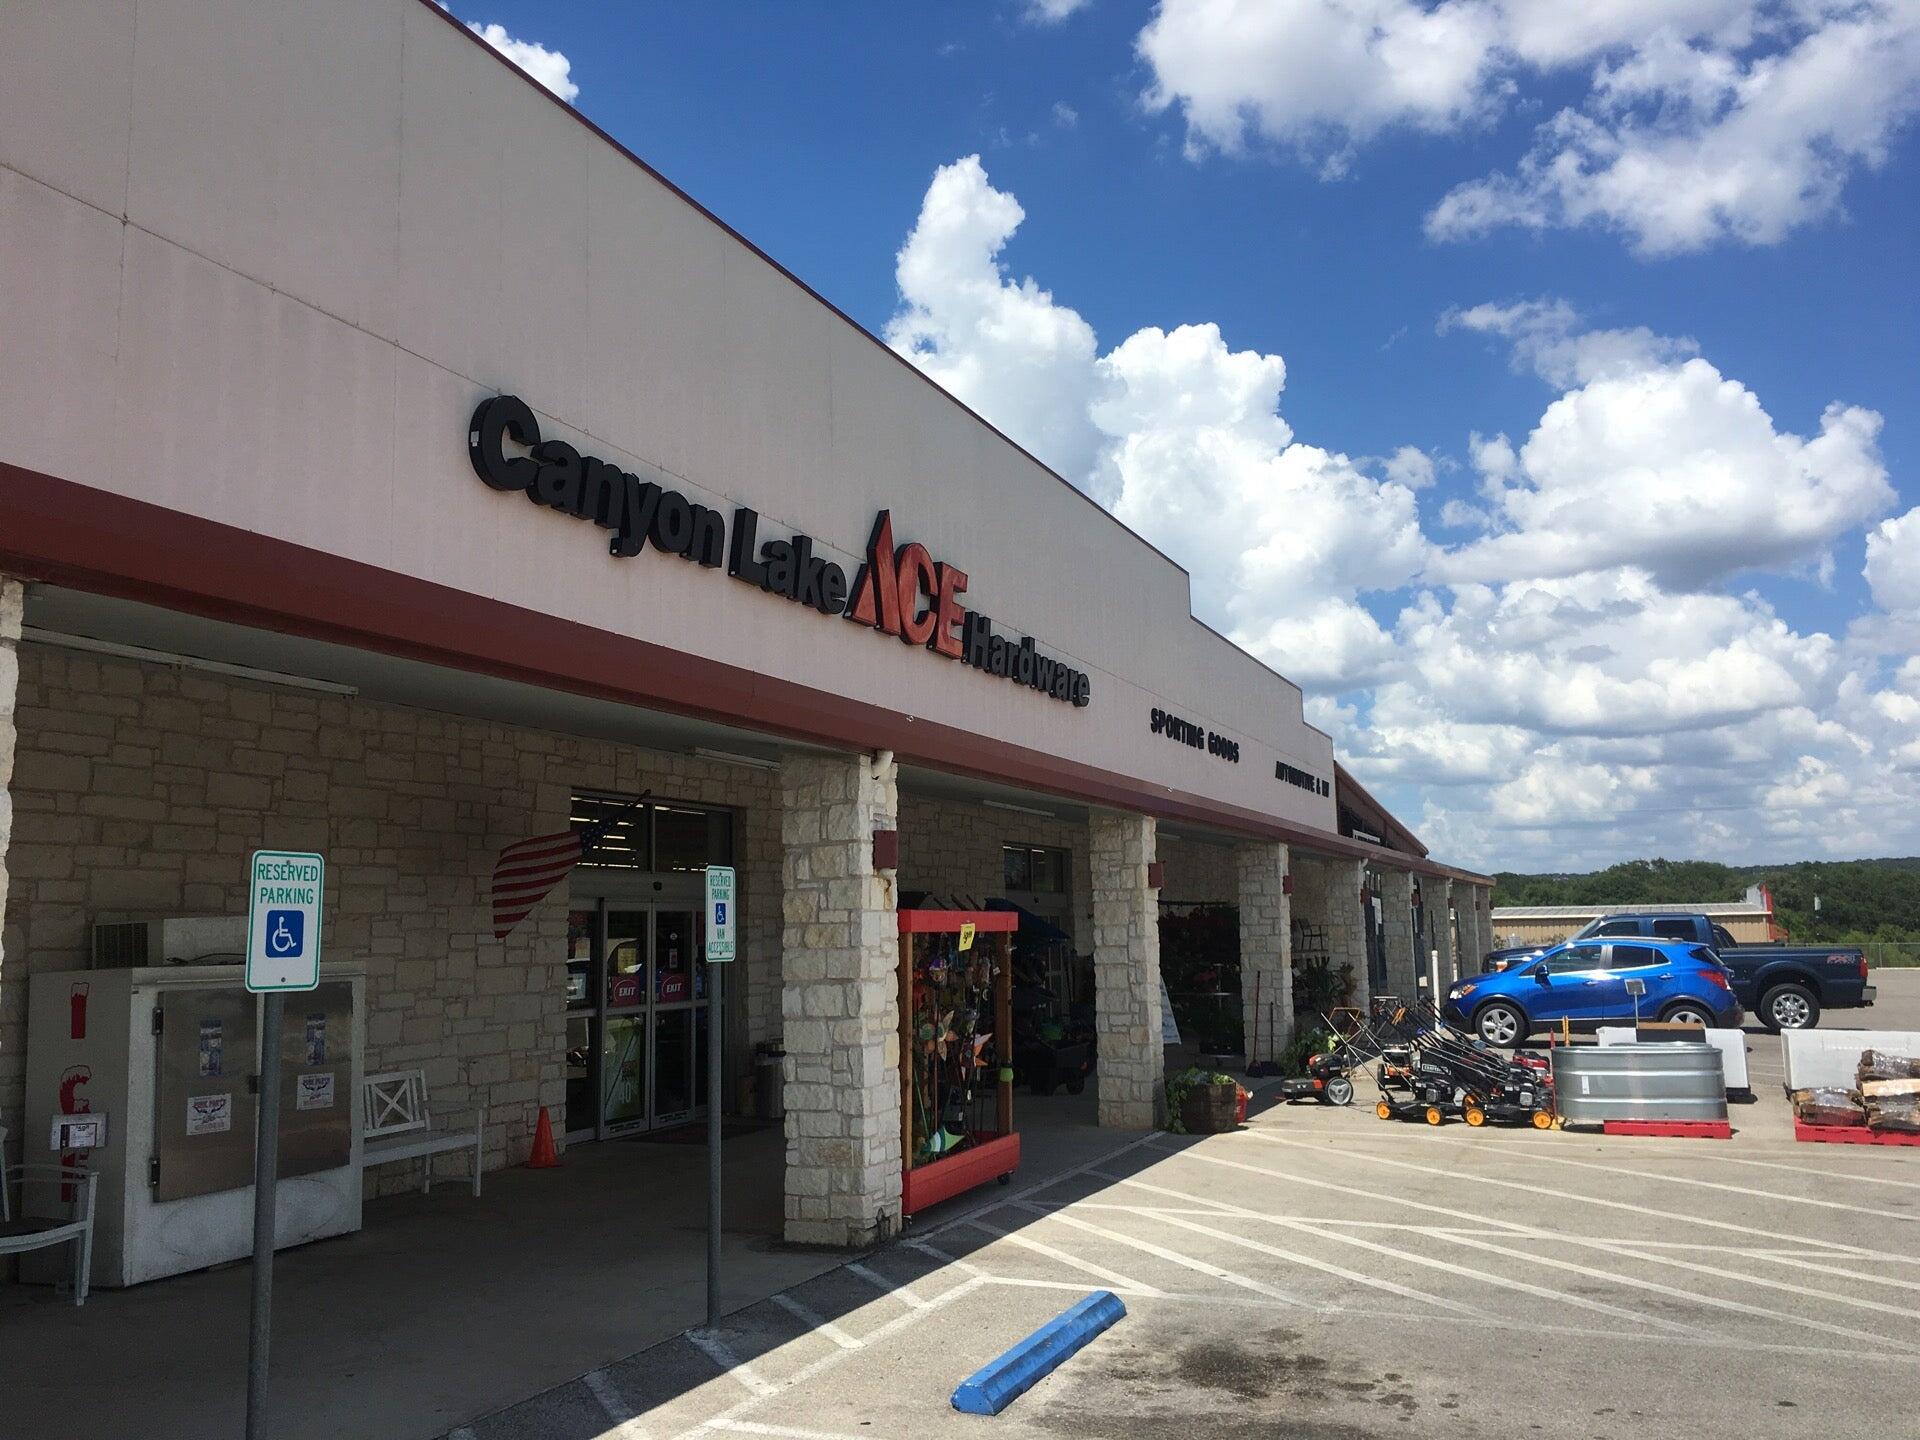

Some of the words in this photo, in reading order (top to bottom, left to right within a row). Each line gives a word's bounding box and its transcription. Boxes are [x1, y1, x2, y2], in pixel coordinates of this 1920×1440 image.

[469, 395, 726, 568] Canyon
[728, 507, 848, 614] Lake
[843, 509, 968, 659] ACE
[961, 611, 1091, 707] Hardware
[1150, 707, 1205, 750] SPORTING
[1207, 731, 1240, 763] GOODS
[1275, 761, 1315, 793] AUTOMOTIVE
[257, 863, 319, 882] RESERVED
[709, 874, 731, 887] RESERVED
[260, 887, 314, 905] PARKING
[711, 888, 730, 900] PARKING
[716, 927, 725, 940] VAN
[708, 941, 734, 953] ACCESSIBLE
[618, 986, 636, 997] EXIT
[665, 983, 682, 993] EXIT
